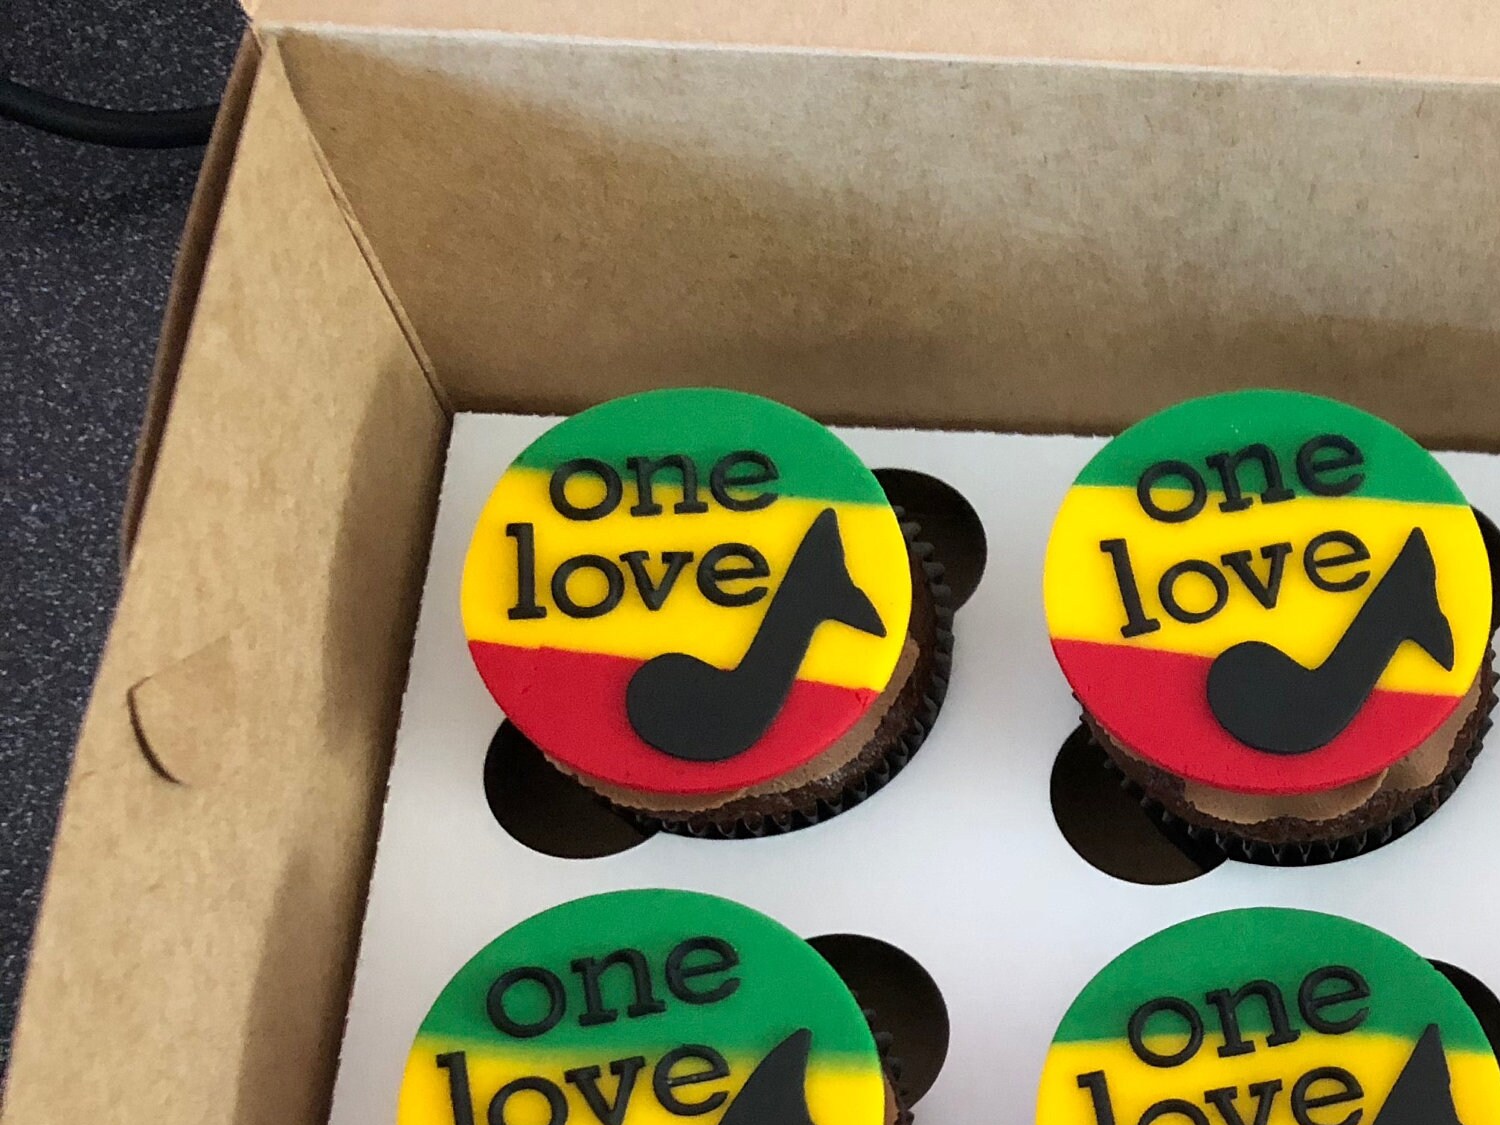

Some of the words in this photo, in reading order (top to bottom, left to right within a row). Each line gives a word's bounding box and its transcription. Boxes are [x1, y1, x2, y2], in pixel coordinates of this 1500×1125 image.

[550, 451, 777, 520] one
[1138, 436, 1363, 521] one
[507, 524, 768, 619] love
[1102, 532, 1368, 637] love
[486, 937, 738, 1039] one
[1127, 966, 1370, 1067] one
